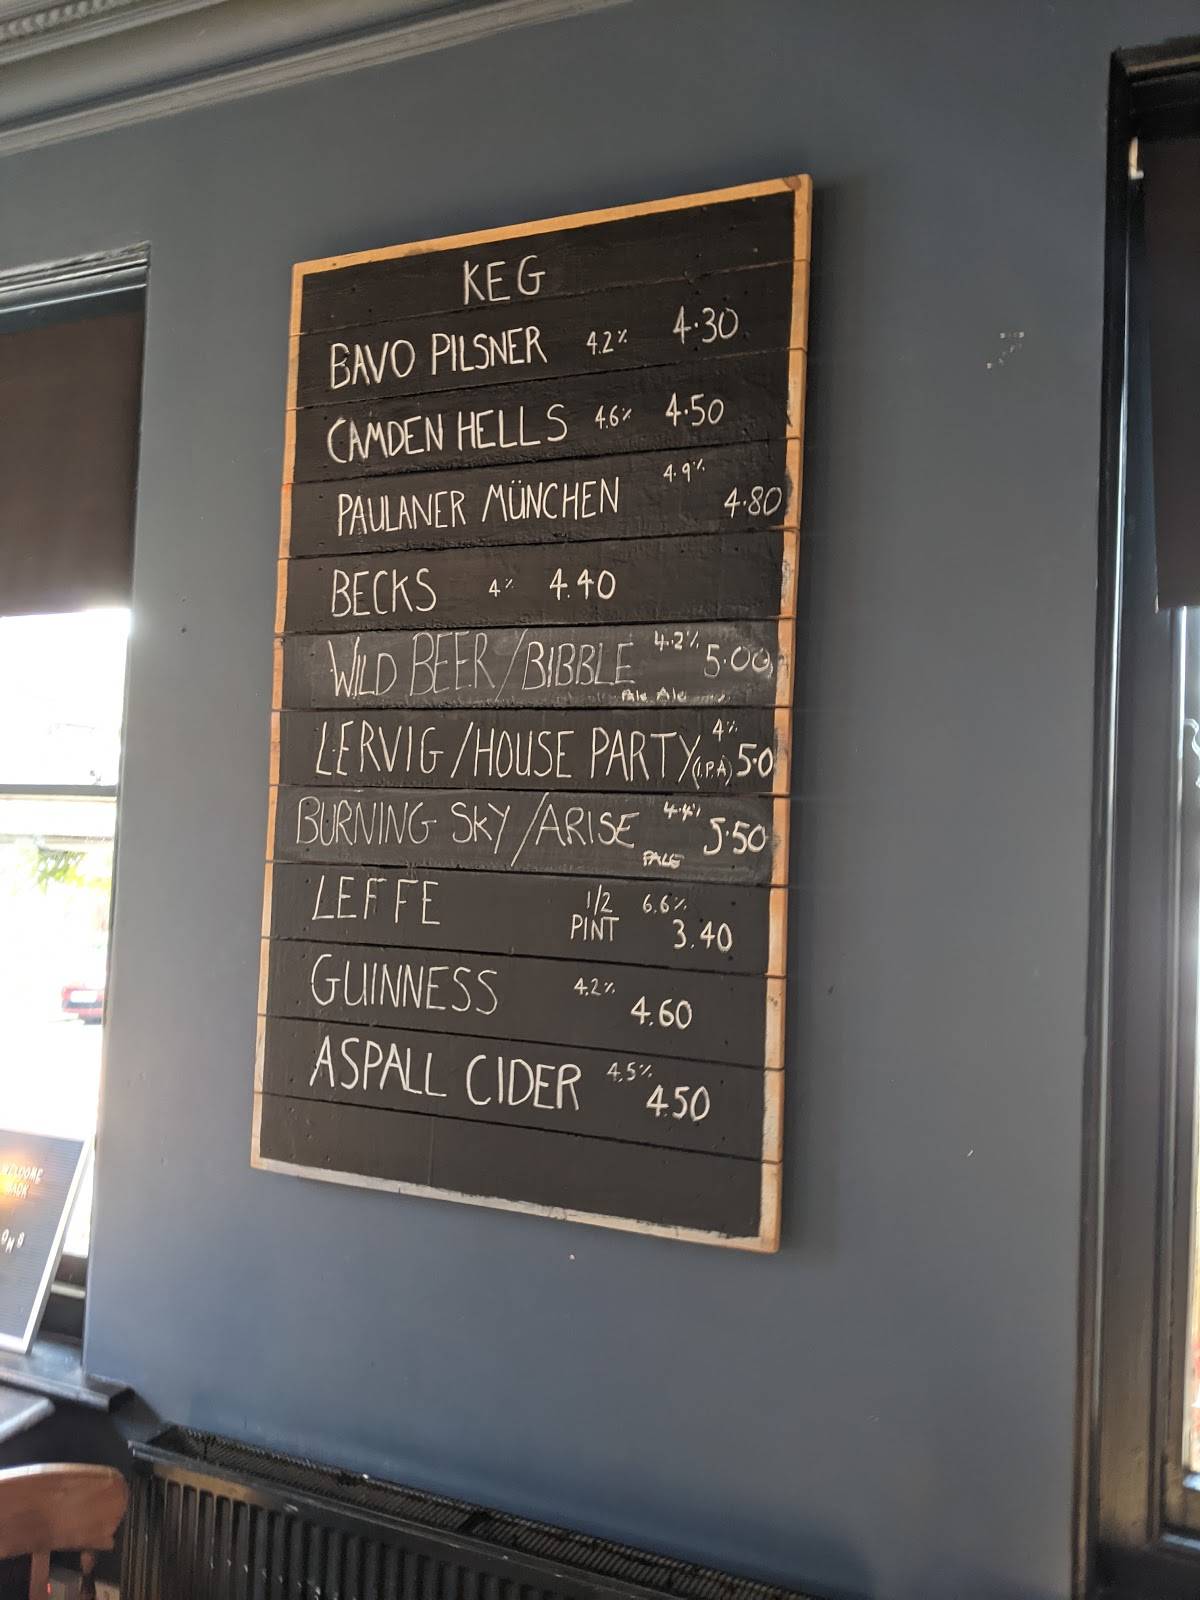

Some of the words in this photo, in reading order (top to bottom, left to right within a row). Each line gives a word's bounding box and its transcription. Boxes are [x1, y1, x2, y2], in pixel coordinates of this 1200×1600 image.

[463, 255, 547, 305] KEG
[329, 339, 416, 390] BAVO
[431, 325, 548, 376] PILSNER
[586, 329, 628, 355] 4.2%
[672, 306, 739, 345] 4.30
[326, 417, 444, 464] CAMDEN
[457, 403, 569, 452] HELLS
[594, 405, 632, 430] 4.6%
[665, 392, 725, 427] 4.50
[337, 490, 466, 537] PAULANER
[481, 476, 620, 524] MÜNCHEN
[724, 486, 783, 519] 4.80
[331, 568, 438, 618] BECKS
[549, 568, 617, 601] 4.40
[327, 636, 398, 699] WILD
[315, 720, 444, 777] LERVIG
[590, 726, 701, 784] PARTY
[295, 796, 437, 847] BURNING
[703, 816, 769, 856] 5.50
[312, 874, 440, 925] LEFFE
[642, 893, 688, 915] 6.6%
[673, 919, 734, 956] 3.40
[570, 916, 620, 944] PINT
[311, 953, 499, 1016] GUINNESS
[574, 977, 616, 997] 4.2%
[630, 995, 693, 1031] 4.60
[309, 1035, 447, 1098] ASPALL
[466, 1054, 582, 1111] CIDER
[606, 1061, 653, 1083] 4.5%
[646, 1084, 711, 1122] 4.50
